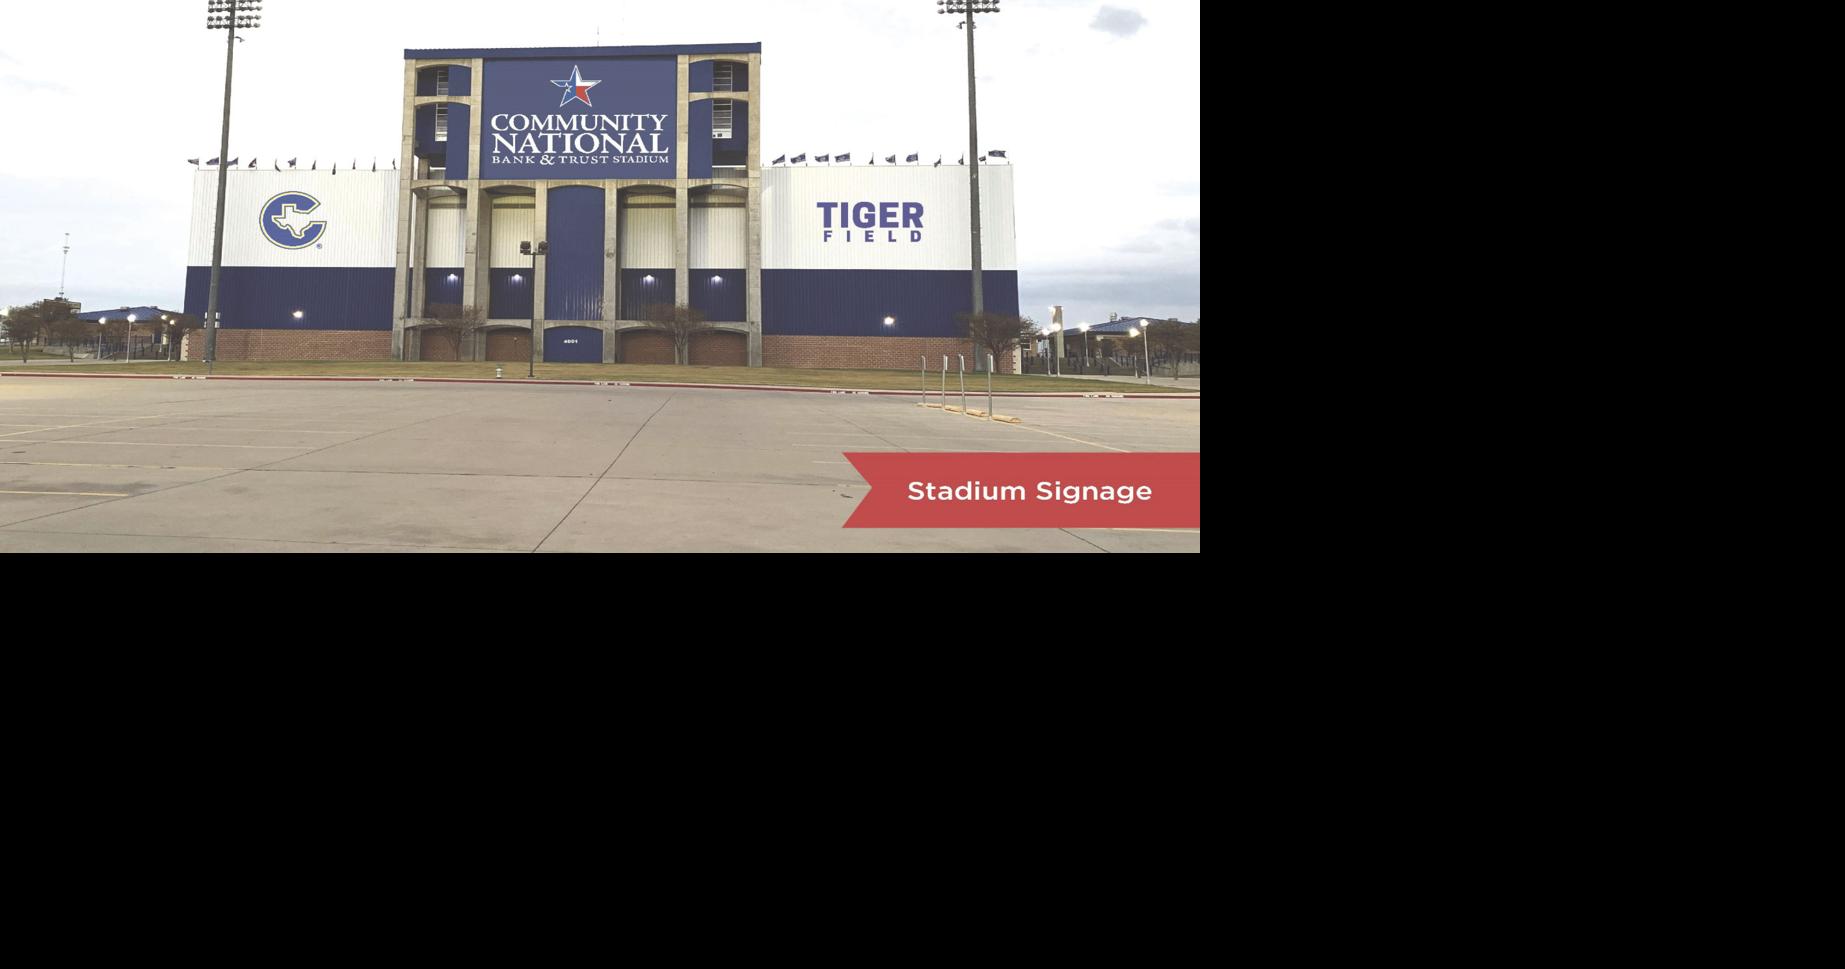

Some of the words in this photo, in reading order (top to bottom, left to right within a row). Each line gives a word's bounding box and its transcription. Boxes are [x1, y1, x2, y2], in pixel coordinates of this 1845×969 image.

[490, 113, 669, 131] COMMUNITY
[491, 132, 669, 154] NATIONAL
[492, 155, 535, 164] BANK
[540, 154, 555, 166] &
[558, 155, 609, 164] TRUST
[612, 155, 669, 164] STADIUM
[816, 201, 924, 228] TIGER
[823, 230, 922, 242] FIELD
